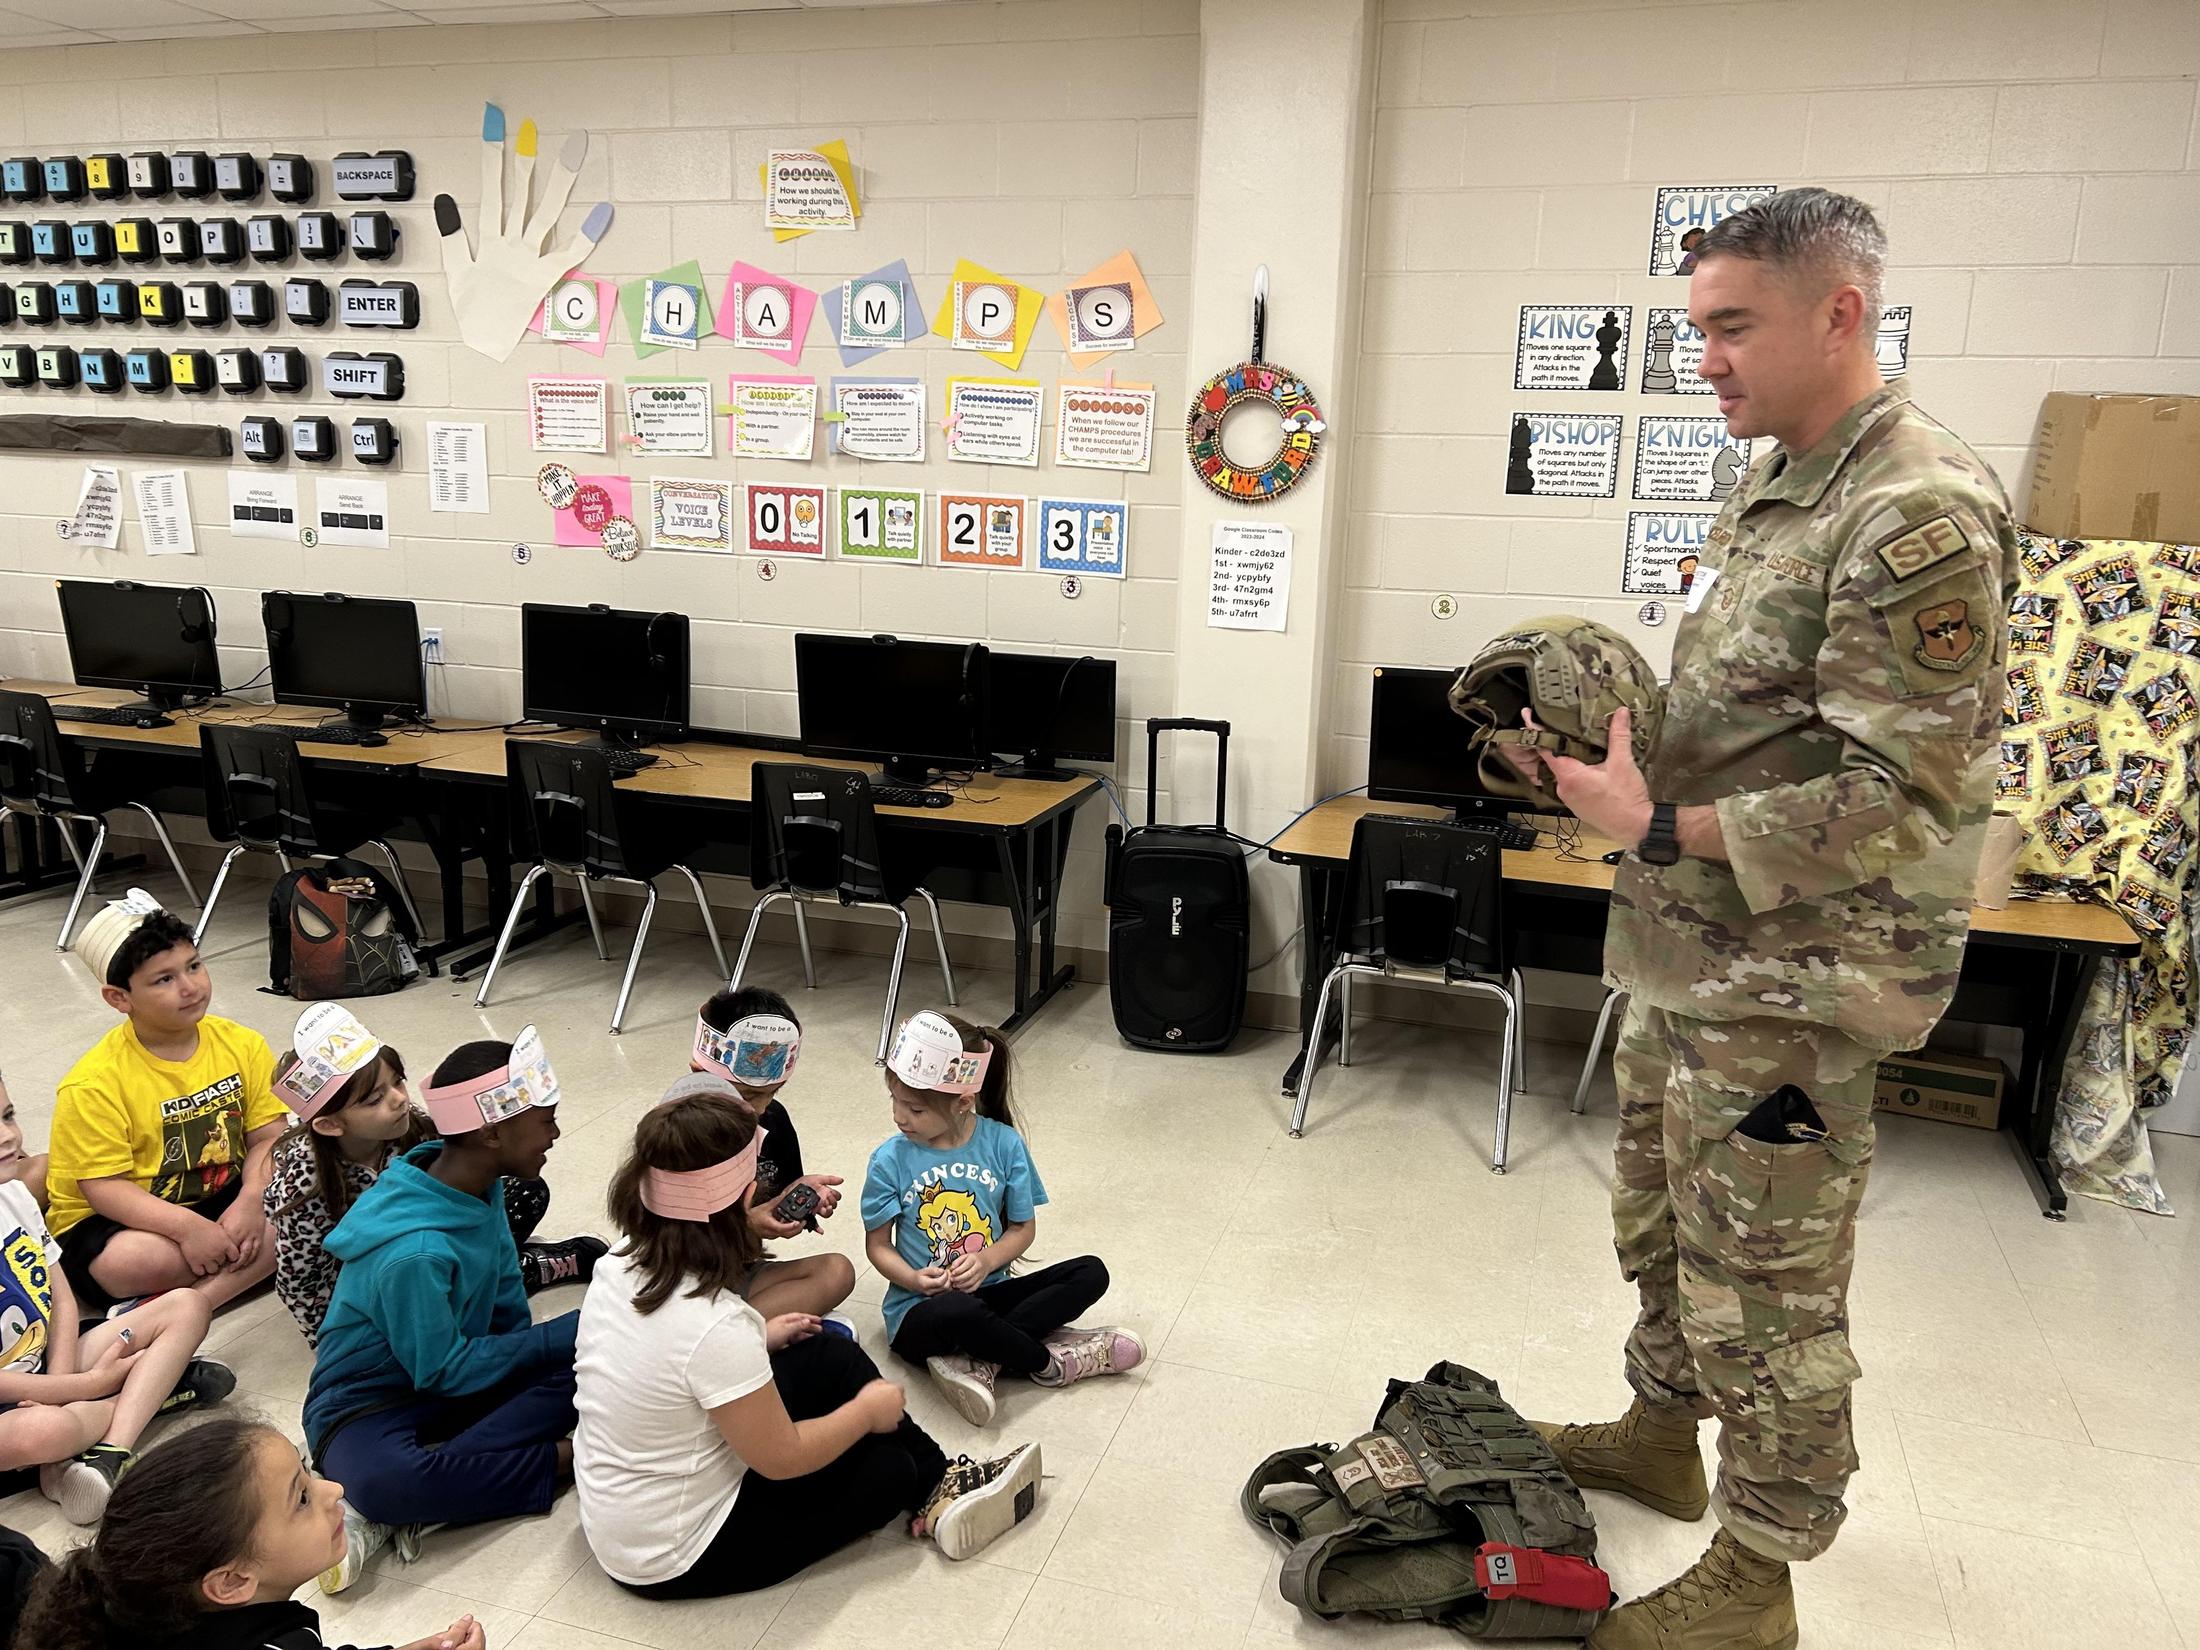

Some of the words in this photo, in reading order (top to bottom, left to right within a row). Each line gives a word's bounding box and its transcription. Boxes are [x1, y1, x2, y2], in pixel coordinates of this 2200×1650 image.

[10, 177, 16, 186] 6
[52, 177, 58, 186] 7
[93, 174, 100, 183] 8
[135, 173, 142, 182] 9
[336, 170, 393, 180] BACKSPACE
[777, 197, 807, 206] working
[809, 198, 832, 206] during
[798, 208, 827, 216] activity.
[0, 232, 8, 244] T
[37, 232, 47, 245] Y
[78, 233, 88, 247] U
[124, 230, 129, 243] I
[163, 231, 174, 244] O
[207, 231, 216, 244] P
[20, 295, 30, 308] G
[62, 294, 71, 306] H
[103, 293, 111, 305] J
[144, 294, 156, 307] K
[189, 295, 199, 308] L
[347, 297, 397, 311] ENTER
[567, 297, 584, 320] C
[666, 301, 682, 326] H
[758, 303, 776, 327] A
[865, 300, 886, 325] M
[981, 302, 999, 327] P
[1094, 302, 1113, 327] S
[1529, 313, 1596, 339] KING
[1526, 343, 1549, 351] Moves
[2, 357, 12, 370] V
[42, 358, 52, 371] B
[87, 362, 99, 375] N
[132, 362, 144, 375] M
[333, 369, 377, 383] SHIFT
[1225, 368, 1274, 395] MRS
[1531, 374, 1549, 382] path
[1071, 416, 1091, 424] When
[244, 430, 262, 443] Alt
[1068, 426, 1099, 434] CHAMPS
[1100, 428, 1141, 437] procedures
[1530, 420, 1615, 445] BISHOP
[353, 433, 376, 447] Ctrl
[1093, 438, 1131, 446] successful
[1085, 446, 1119, 454] computer
[1538, 448, 1561, 456] Moves
[543, 468, 562, 485] MAKE
[1552, 479, 1569, 487] path
[580, 491, 600, 502] MAKE
[663, 490, 719, 500] CONVERSATION
[675, 503, 708, 515] VOICE
[584, 511, 605, 523] GREAT
[670, 515, 713, 529] LEVELS
[760, 502, 779, 533] 0
[854, 507, 869, 538] 1
[954, 513, 975, 545] 2
[1053, 519, 1074, 551] 3
[1891, 521, 1953, 570] SF
[1215, 547, 1242, 556] Kinder
[1249, 549, 1285, 558] c2de3zd
[1214, 559, 1228, 567] 1st
[1237, 562, 1274, 571] xwmjy62
[1642, 556, 1676, 566] Respect
[1641, 568, 1662, 577] Quiet
[2072, 567, 2098, 584] SHE
[2099, 558, 2131, 575] WHO
[1236, 574, 1271, 583] ycpybfy
[1640, 581, 1666, 589] voices
[1067, 581, 1076, 593] 3
[1233, 585, 1274, 595] 47n2gm4
[1232, 598, 1270, 608] rmxsy6p
[2167, 593, 2192, 606] SHE
[1229, 610, 1258, 618] u7afrrt
[1439, 601, 1450, 614] 2
[1646, 606, 1656, 621] 1
[2045, 728, 2070, 742] SHE
[2071, 719, 2094, 737] WHO
[2128, 882, 2152, 899] SHE
[304, 1017, 317, 1031] want
[751, 1023, 768, 1031] want
[902, 1162, 999, 1206] PRINCESS
[1494, 1555, 1509, 1581] TQ
